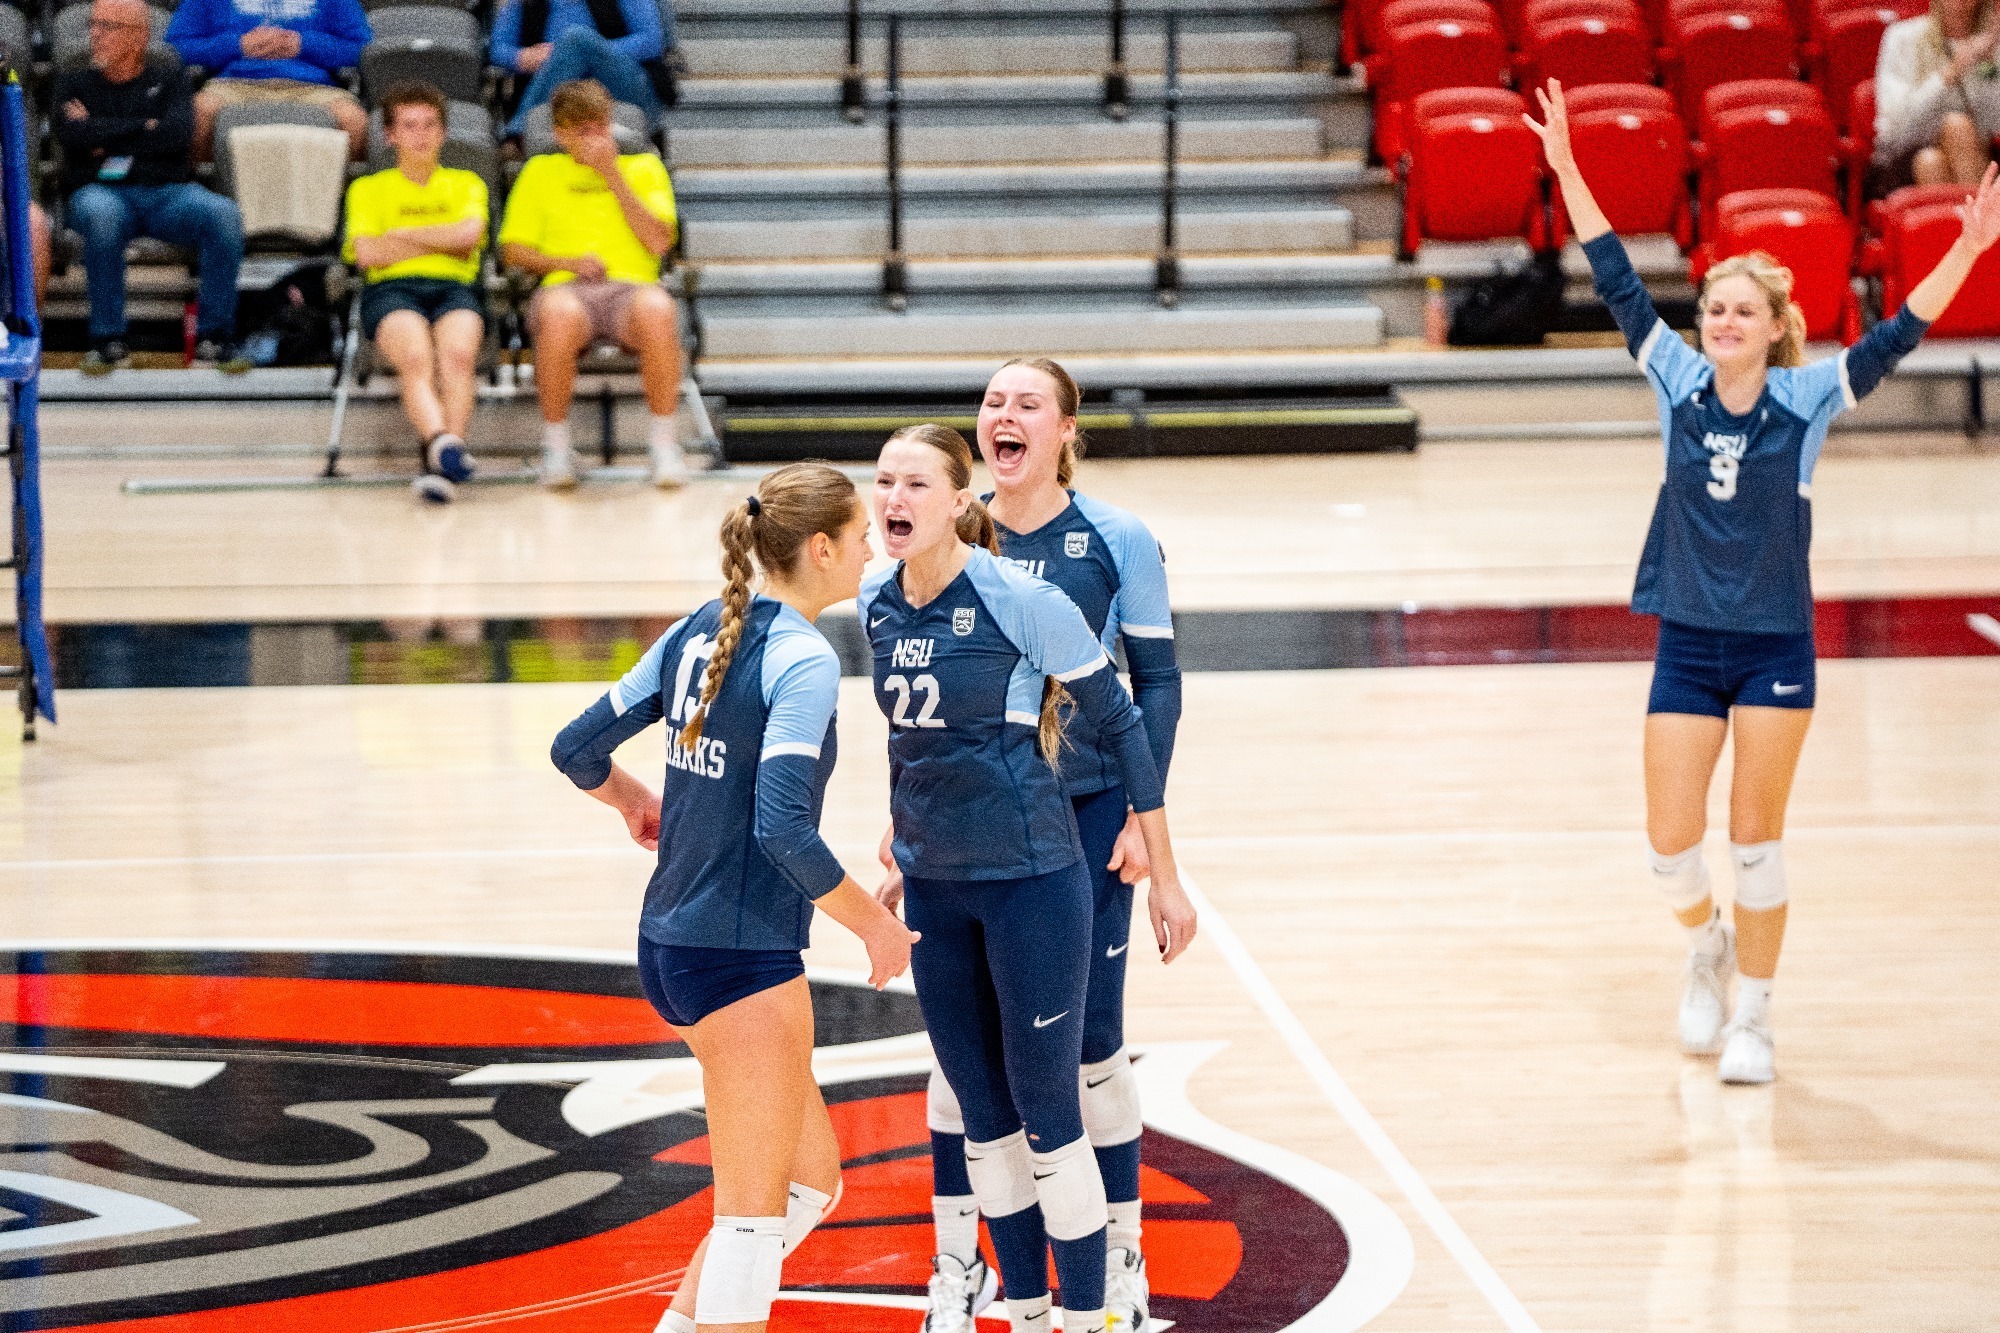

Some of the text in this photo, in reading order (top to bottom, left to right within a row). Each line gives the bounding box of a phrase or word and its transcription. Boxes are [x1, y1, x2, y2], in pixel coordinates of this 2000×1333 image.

[1706, 454, 1739, 500] 9
[891, 639, 934, 667] NSU
[884, 674, 947, 728] 22
